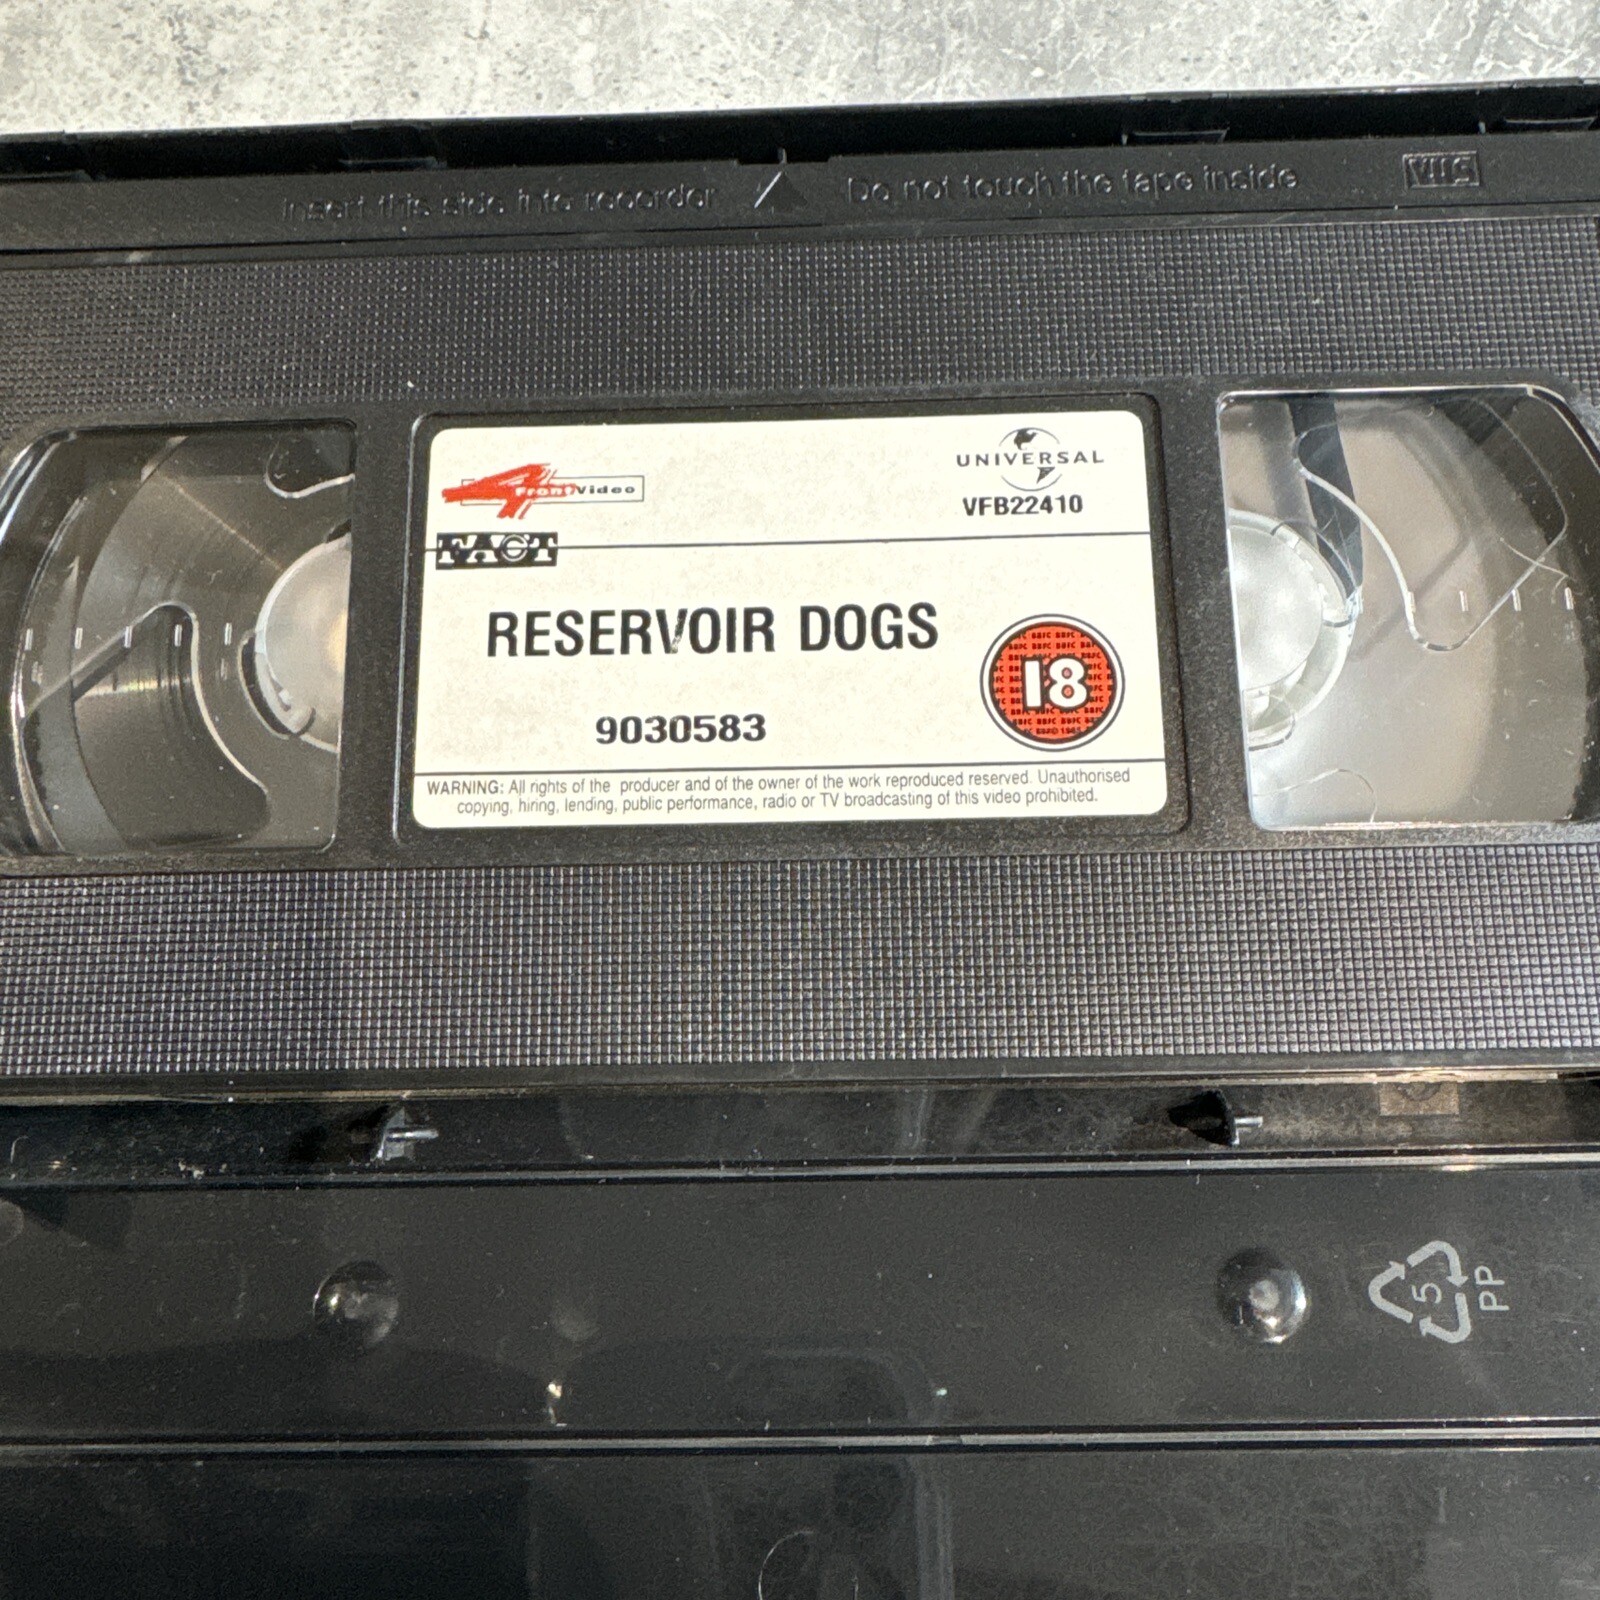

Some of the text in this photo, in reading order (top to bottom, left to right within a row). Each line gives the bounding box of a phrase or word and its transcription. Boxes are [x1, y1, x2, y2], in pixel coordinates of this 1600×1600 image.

[847, 164, 1298, 201] Do not touch the tape inside
[378, 193, 430, 218] this
[442, 191, 504, 215] side
[518, 188, 572, 214] into
[585, 184, 716, 212] recorder
[957, 450, 1105, 467] UNIVERSAL
[575, 484, 636, 496] Video
[963, 494, 1083, 516] VFB22410
[437, 533, 558, 568] FACT
[487, 602, 938, 657] RESERVOIR DOGS
[1022, 657, 1090, 711] 18
[596, 714, 766, 744] 9030583
[427, 768, 1130, 798] WARNING: All rights of the producer and of the owner of the work reproduced reserved. Unauthorised
[457, 787, 1098, 817] copying, hiring, lending, public performance, radio or TV broadcasting of this video prohibited.
[1411, 1282, 1442, 1304] 5
[1474, 1265, 1510, 1311] PP
